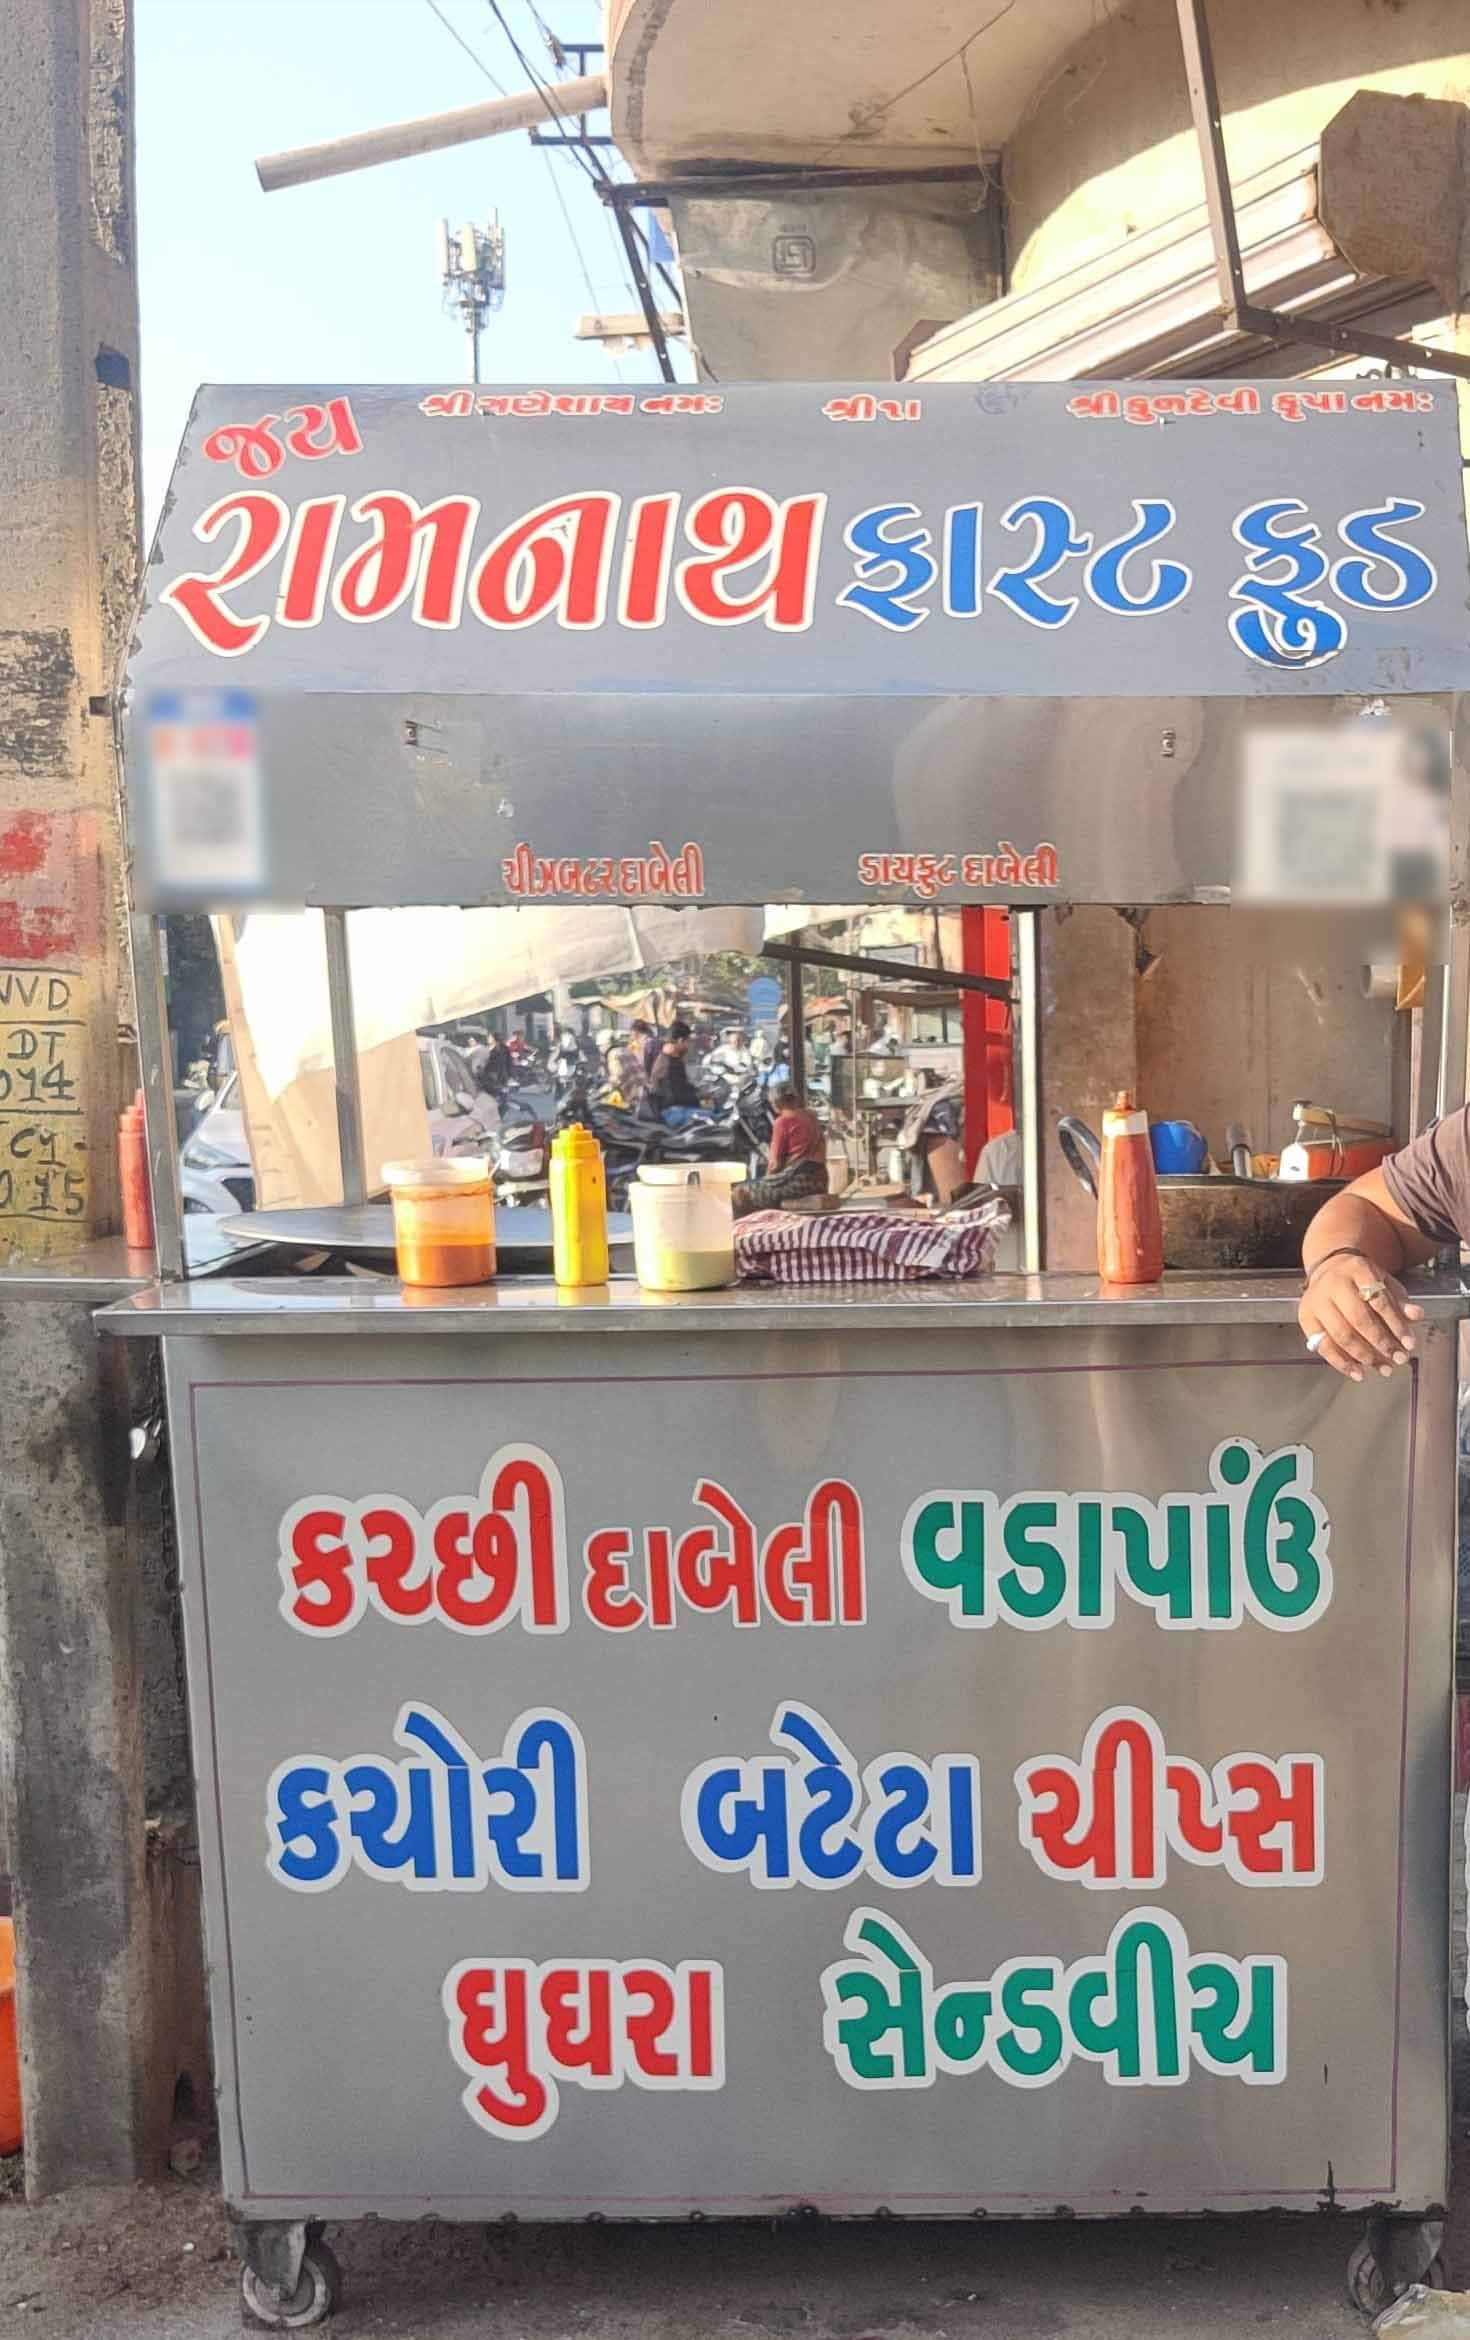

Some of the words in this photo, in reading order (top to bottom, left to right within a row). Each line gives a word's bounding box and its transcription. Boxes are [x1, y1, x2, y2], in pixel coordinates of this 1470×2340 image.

[201, 394, 363, 479] જય
[278, 1442, 570, 1638] કચ્છી
[583, 1478, 867, 1632] દાબેલી
[900, 1436, 1334, 1632] વડાપાંઉ
[266, 1700, 590, 1892] કચોરી
[681, 1700, 981, 1890] બટેટા
[1015, 1706, 1324, 1889] ચીપ્સ
[442, 1958, 726, 2140] ઘુઘરા
[820, 1906, 1288, 2088] સેન્ડવીચ
